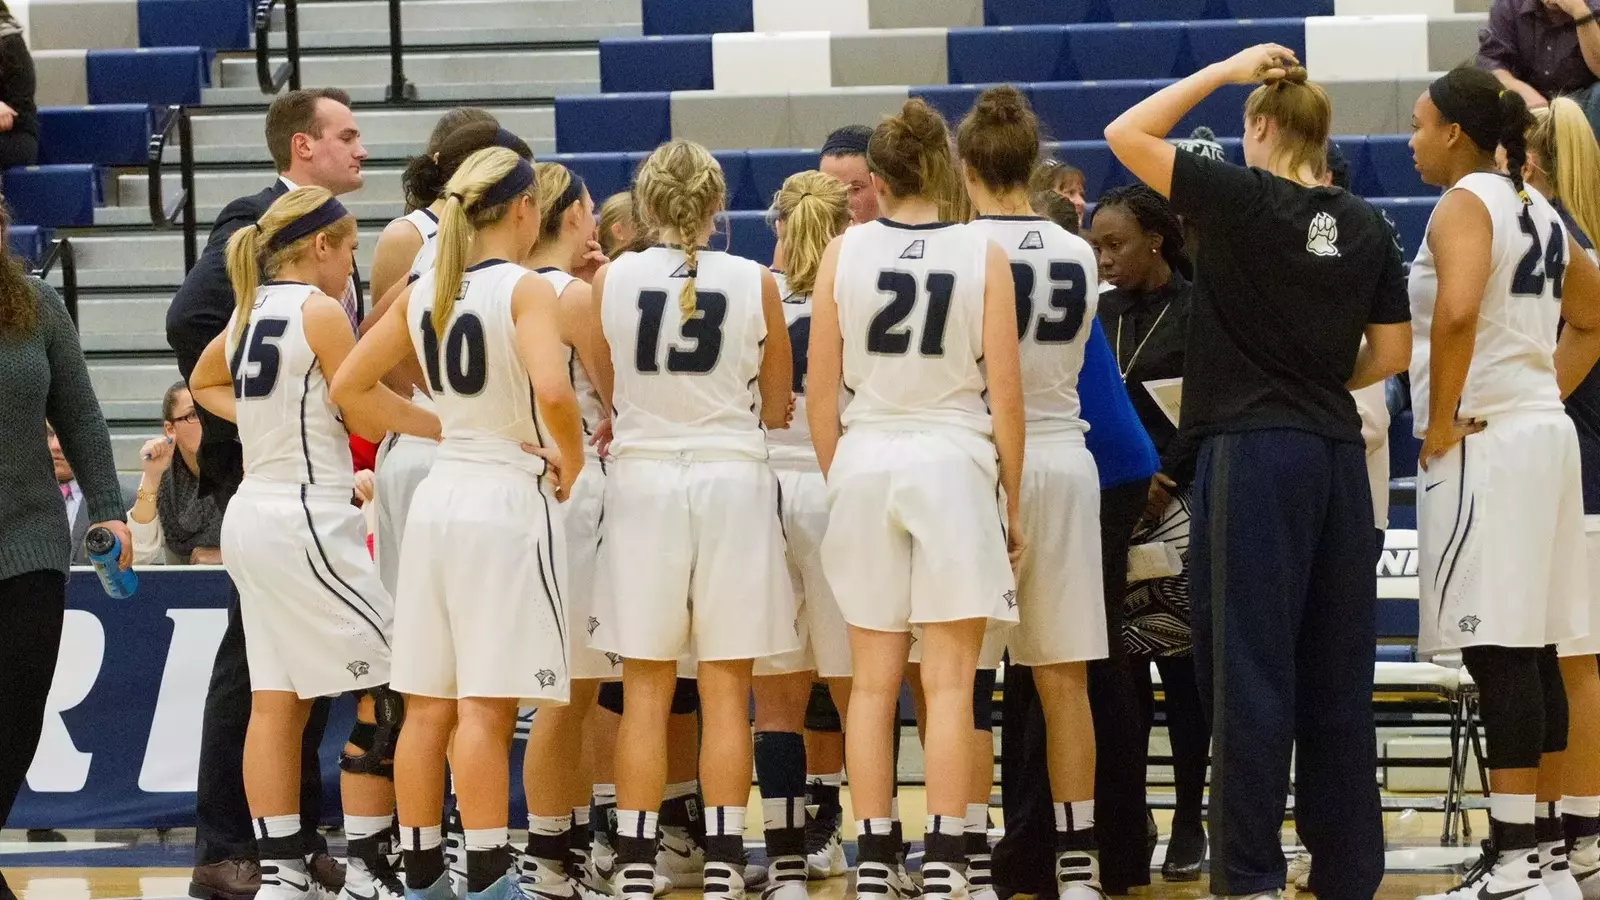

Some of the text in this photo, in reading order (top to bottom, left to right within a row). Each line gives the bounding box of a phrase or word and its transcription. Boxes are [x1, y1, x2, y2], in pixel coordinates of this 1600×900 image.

[1509, 211, 1566, 302] 24
[420, 307, 488, 398] 10
[634, 287, 729, 375] 13
[866, 268, 957, 358] 21
